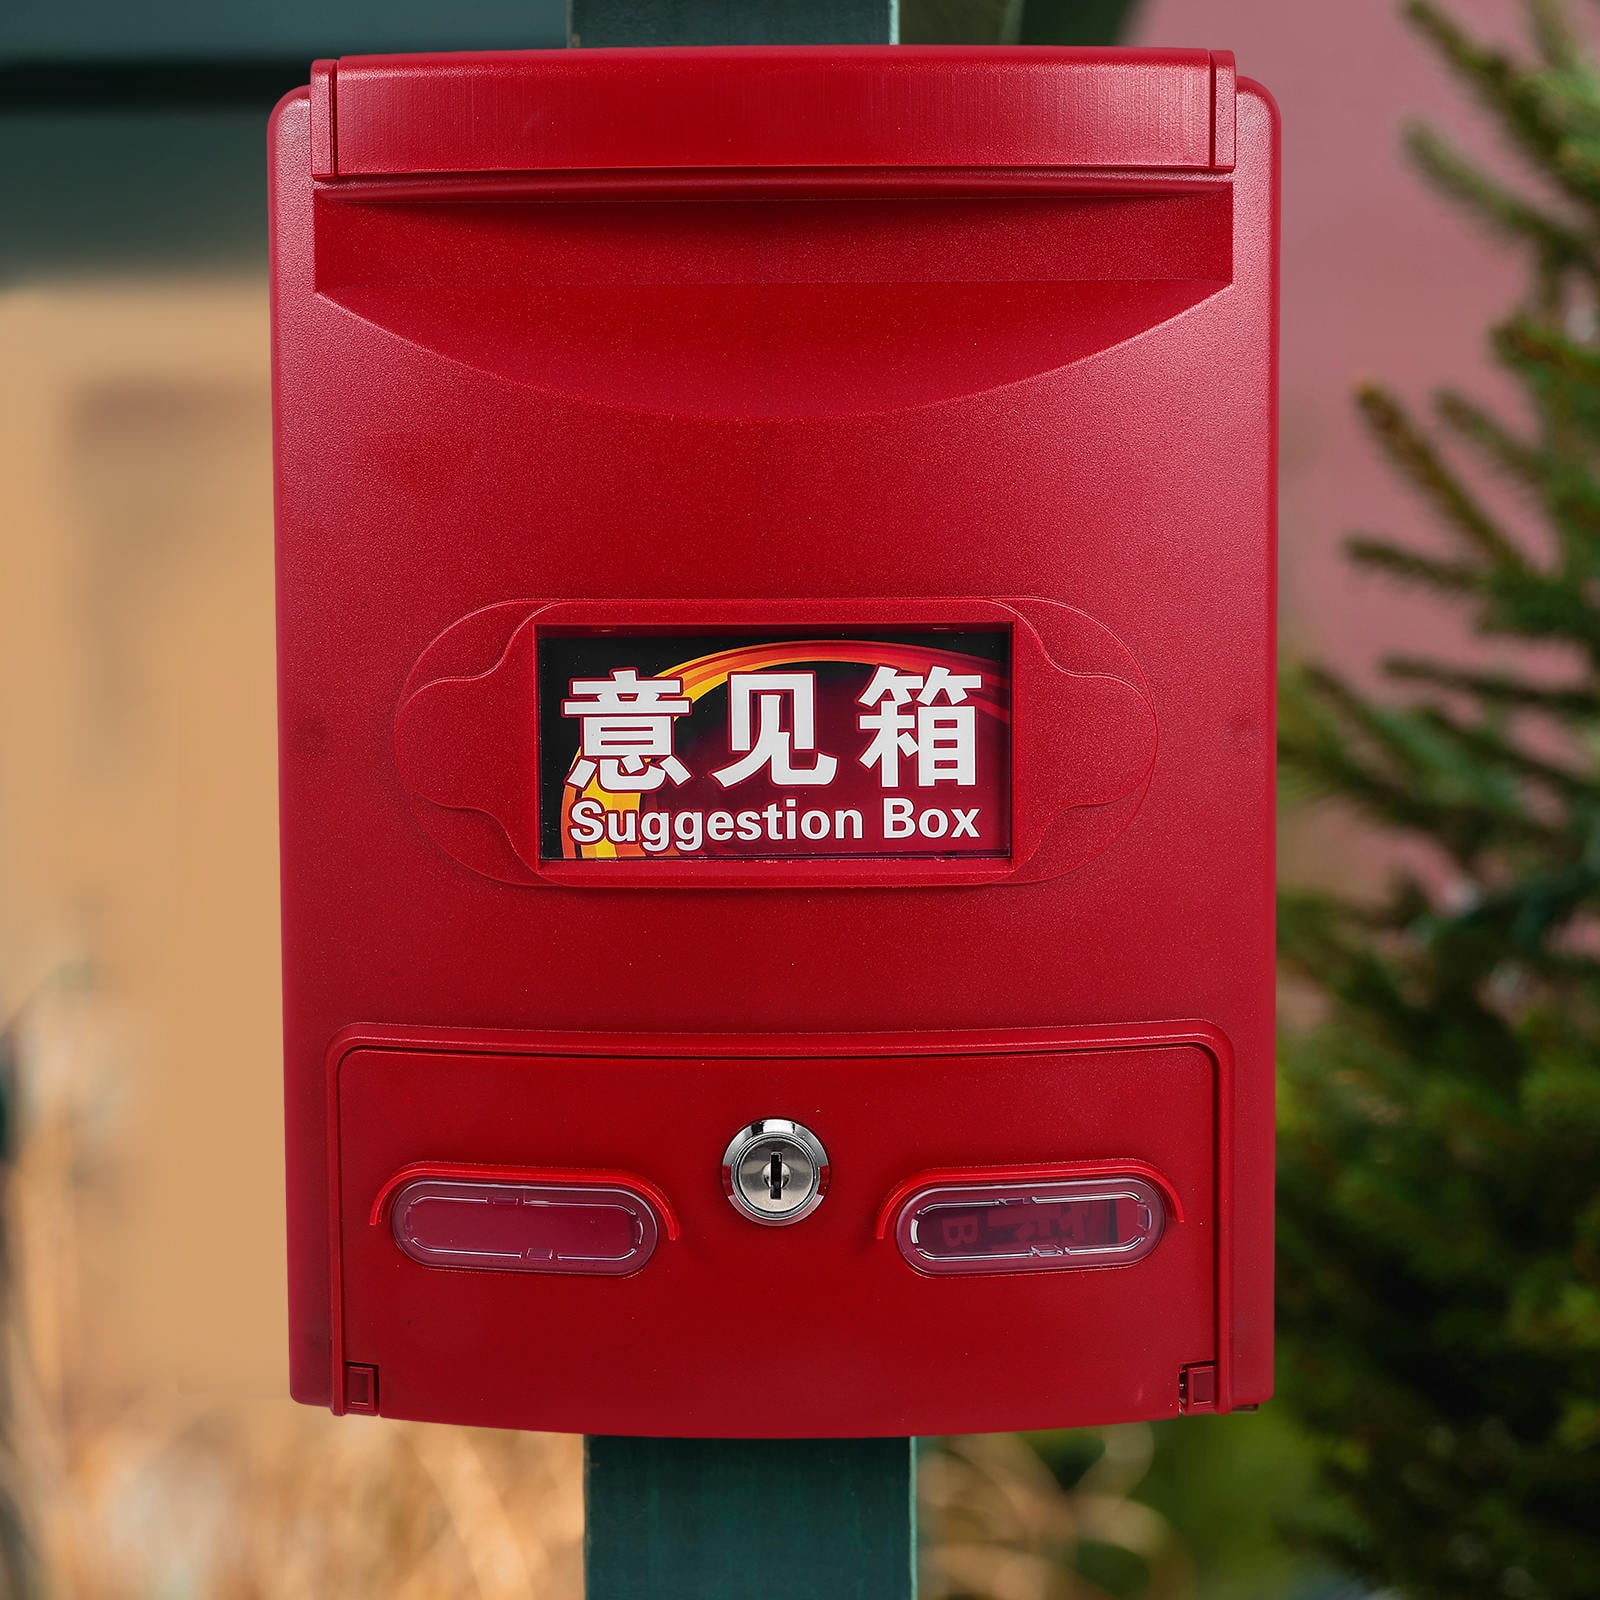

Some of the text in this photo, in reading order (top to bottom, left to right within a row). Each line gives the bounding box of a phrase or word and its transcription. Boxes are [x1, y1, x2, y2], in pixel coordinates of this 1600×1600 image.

[564, 666, 982, 791] 意见箱
[570, 797, 980, 852] Suggestion Box
